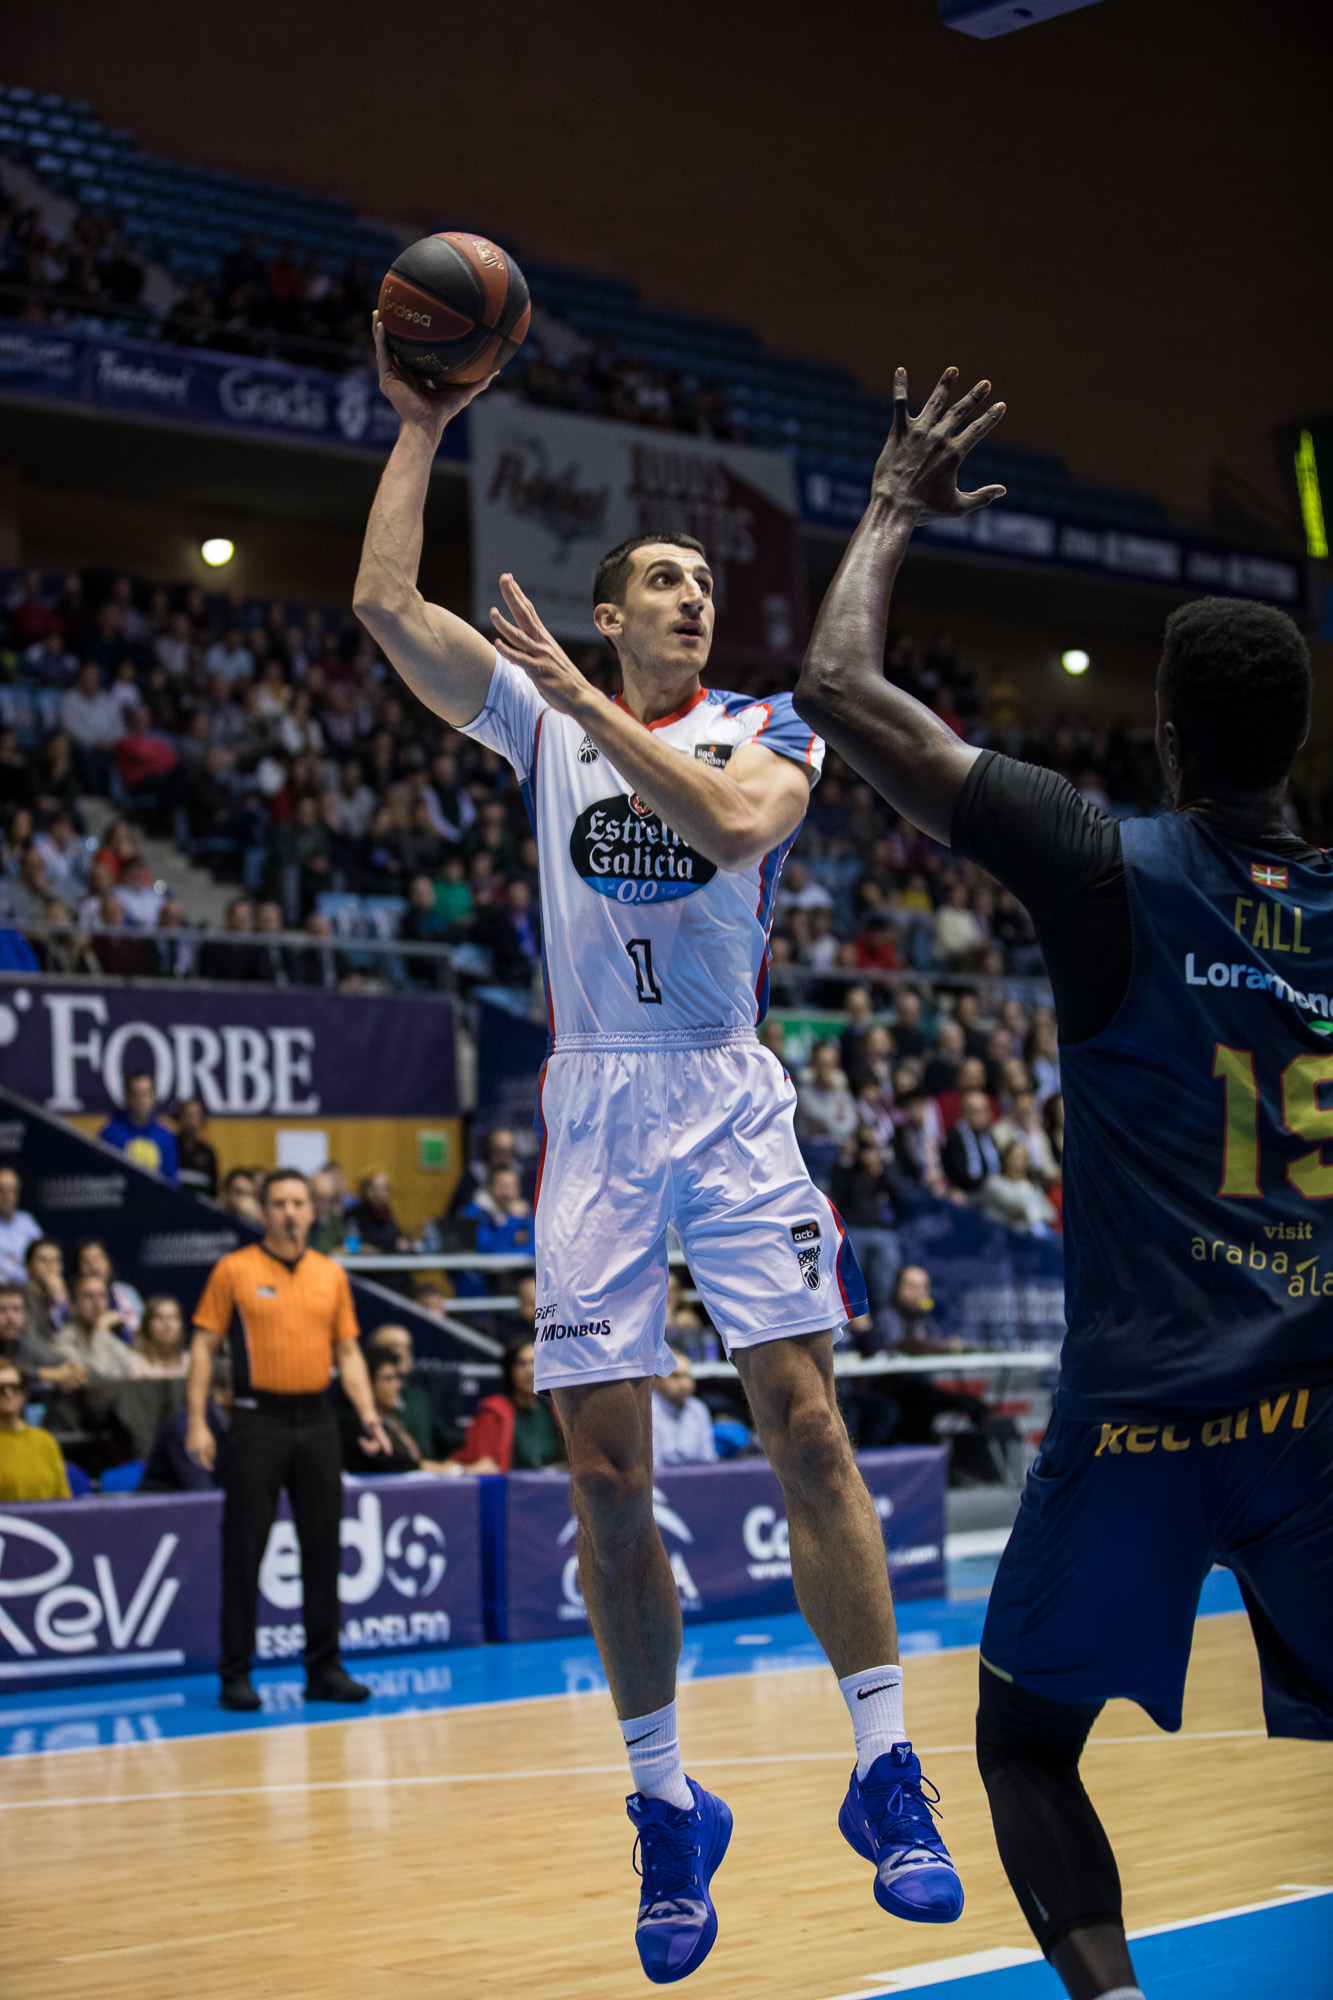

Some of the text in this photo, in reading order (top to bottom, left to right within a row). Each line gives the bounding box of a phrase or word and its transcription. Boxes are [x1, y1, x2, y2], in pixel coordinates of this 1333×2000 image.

[585, 810, 689, 847] Estrell
[589, 842, 694, 879] Galicia
[1234, 896, 1312, 955] FALL
[625, 938, 662, 1005] 1
[42, 994, 320, 1115] FORBE
[795, 1230, 814, 1241] acb
[1263, 1221, 1313, 1240] visit
[797, 1245, 821, 1260] OBRA
[1190, 1236, 1289, 1274] araba
